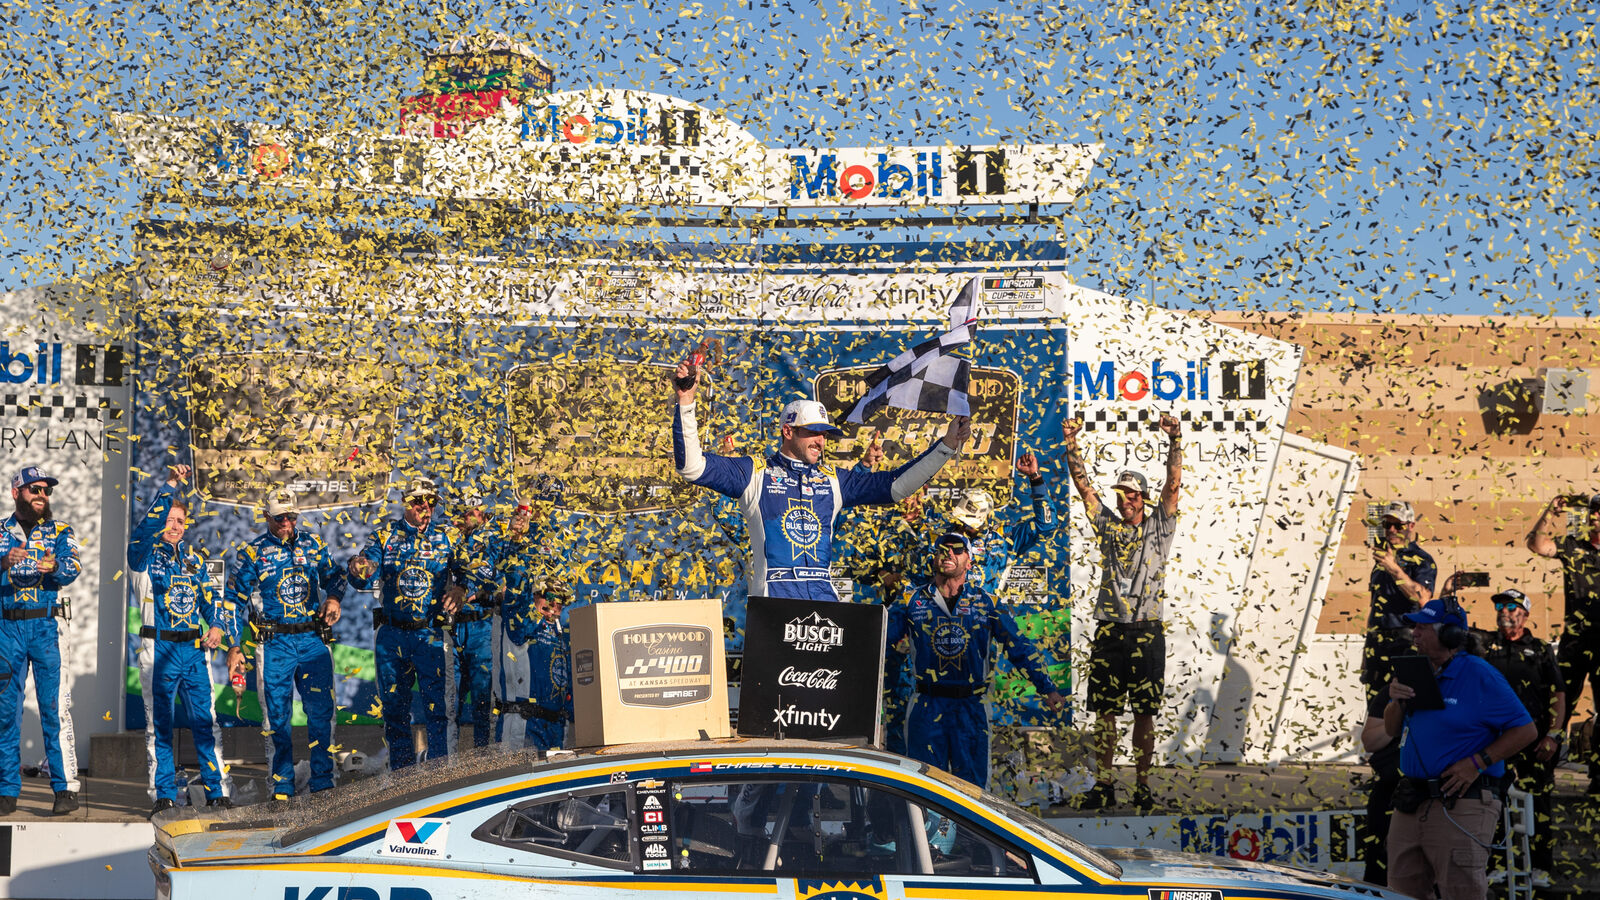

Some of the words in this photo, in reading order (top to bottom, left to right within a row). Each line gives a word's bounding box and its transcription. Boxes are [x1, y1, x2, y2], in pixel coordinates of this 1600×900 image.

[521, 104, 648, 145] Mobil
[791, 152, 943, 200] Mobil
[1003, 279, 1036, 289] NASCAR
[873, 285, 953, 307] xfinity
[992, 292, 1008, 300] CUP
[1074, 360, 1209, 401] Mobil
[46, 428, 121, 451] LANE
[1199, 442, 1268, 463] LANE
[788, 510, 816, 523] KELLEY
[785, 521, 802, 531] BLUE
[803, 523, 818, 532] BOOK
[623, 632, 706, 645] HOLLYWOOD
[783, 624, 844, 646] BUSCH
[644, 641, 683, 655] Casino
[658, 655, 703, 674] 400
[778, 666, 842, 690] Coca-Cola
[773, 705, 841, 731] xfinity
[715, 762, 777, 770] CHASE
[778, 762, 857, 772] ELLIOTT
[1181, 815, 1318, 862] Mobil
[389, 845, 437, 856] Valvoline
[645, 843, 668, 854] MAC
[1172, 891, 1212, 900] NASCAR
